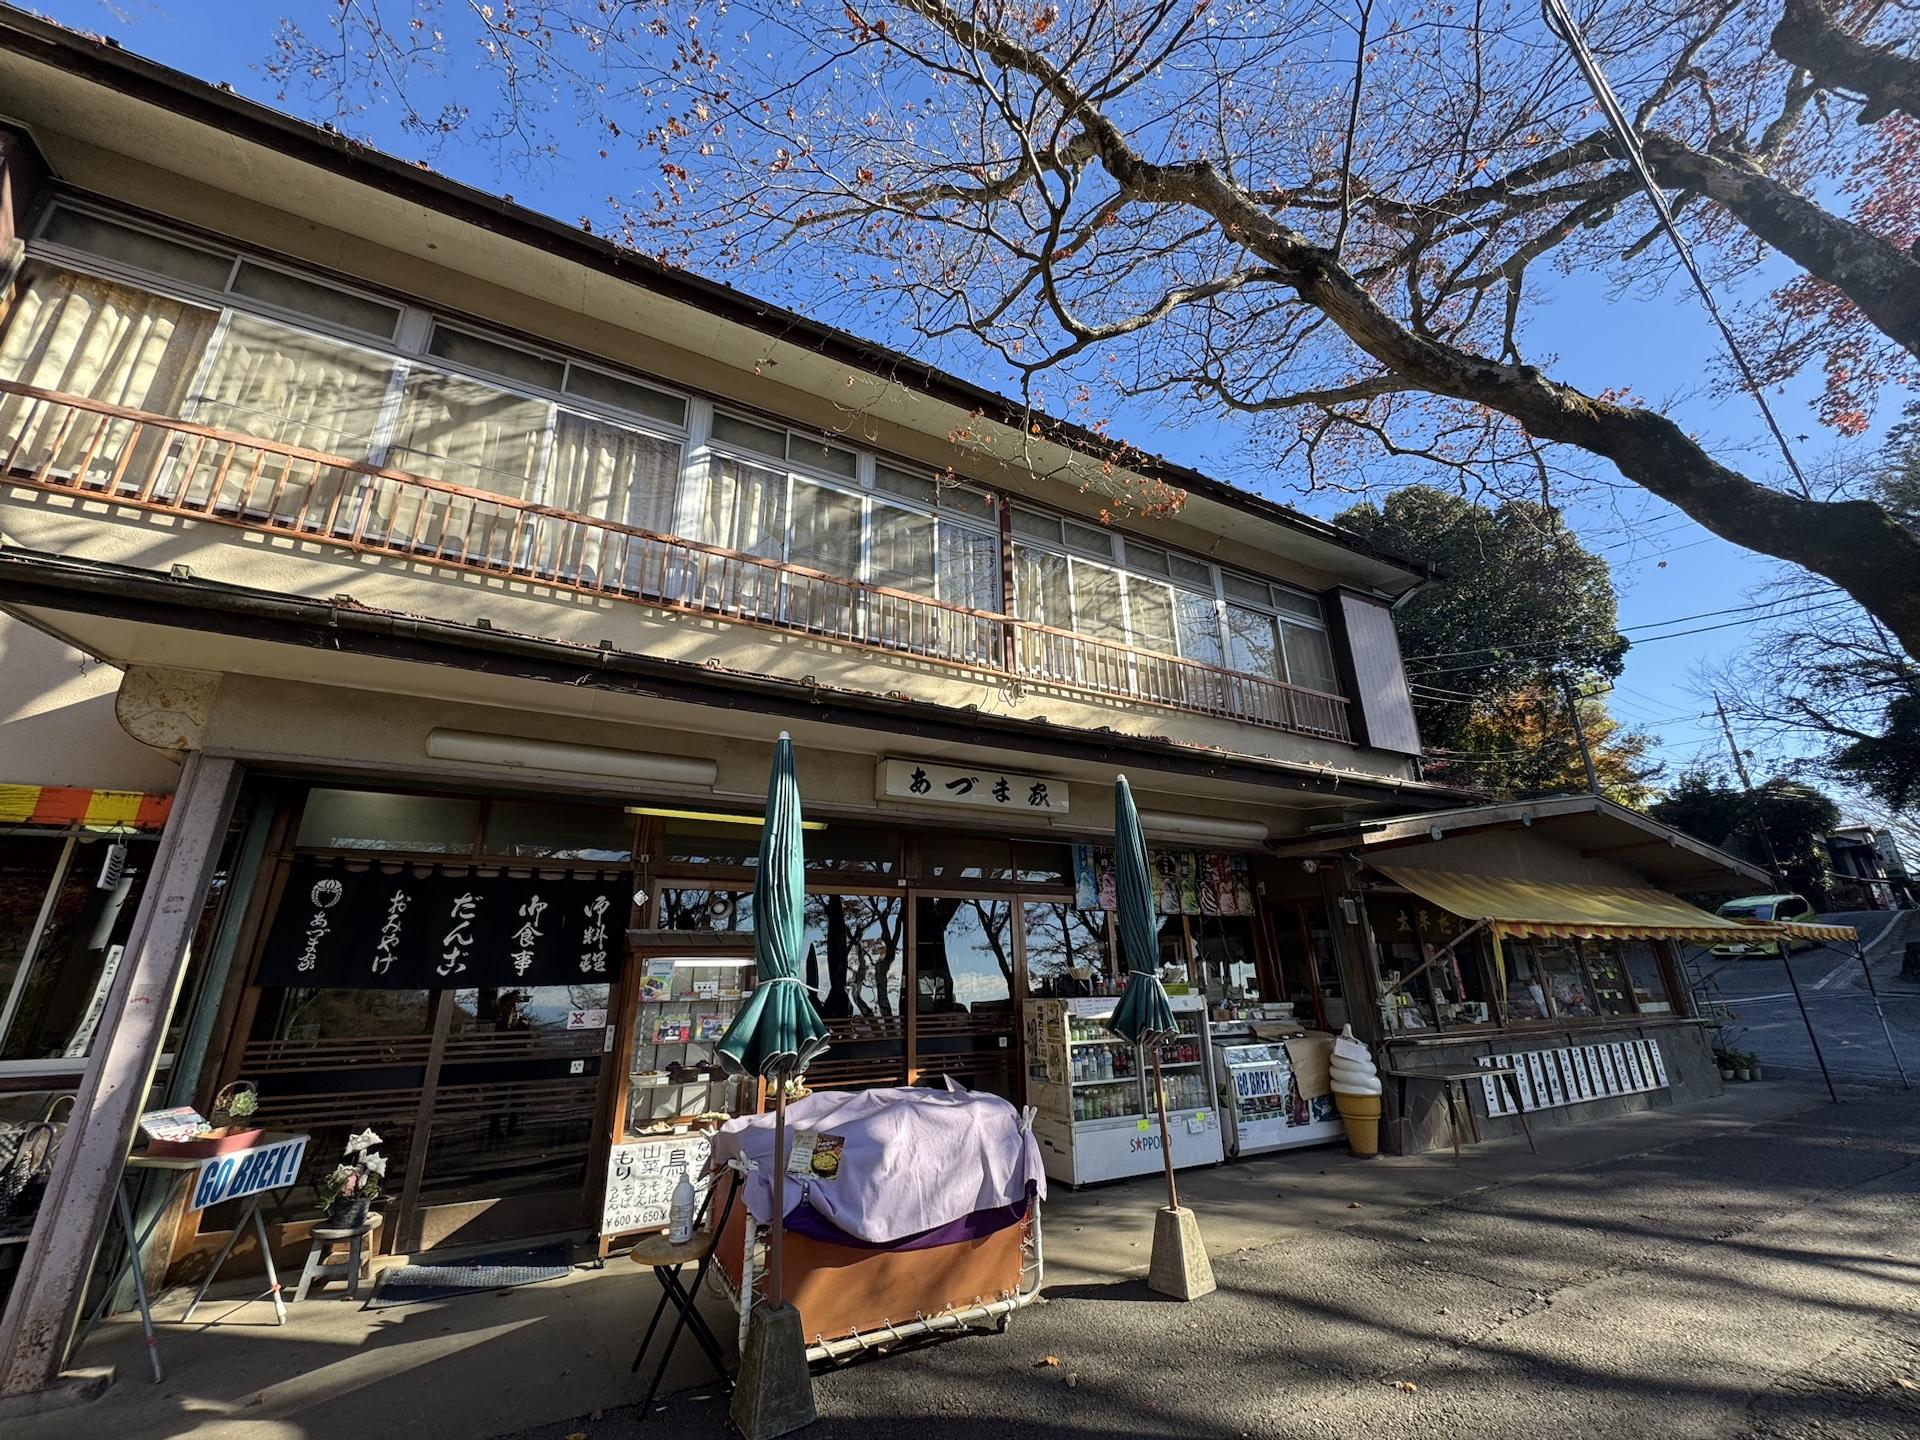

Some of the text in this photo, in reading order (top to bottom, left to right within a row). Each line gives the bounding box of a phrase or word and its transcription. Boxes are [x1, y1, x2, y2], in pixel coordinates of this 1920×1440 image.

[909, 766, 1051, 807] あづま家
[297, 911, 331, 971] あづま家
[371, 890, 411, 974] おみやげ
[436, 892, 484, 976] だんご
[511, 895, 548, 976] 御食事
[579, 895, 611, 973] 御料理
[195, 1143, 303, 1207] GO BREX!
[615, 1150, 634, 1180] もり
[641, 1145, 661, 1174] 山菜
[607, 1186, 619, 1211] うどん
[620, 1184, 633, 1208] そば
[636, 1183, 647, 1206] うどん
[648, 1181, 660, 1204] そば
